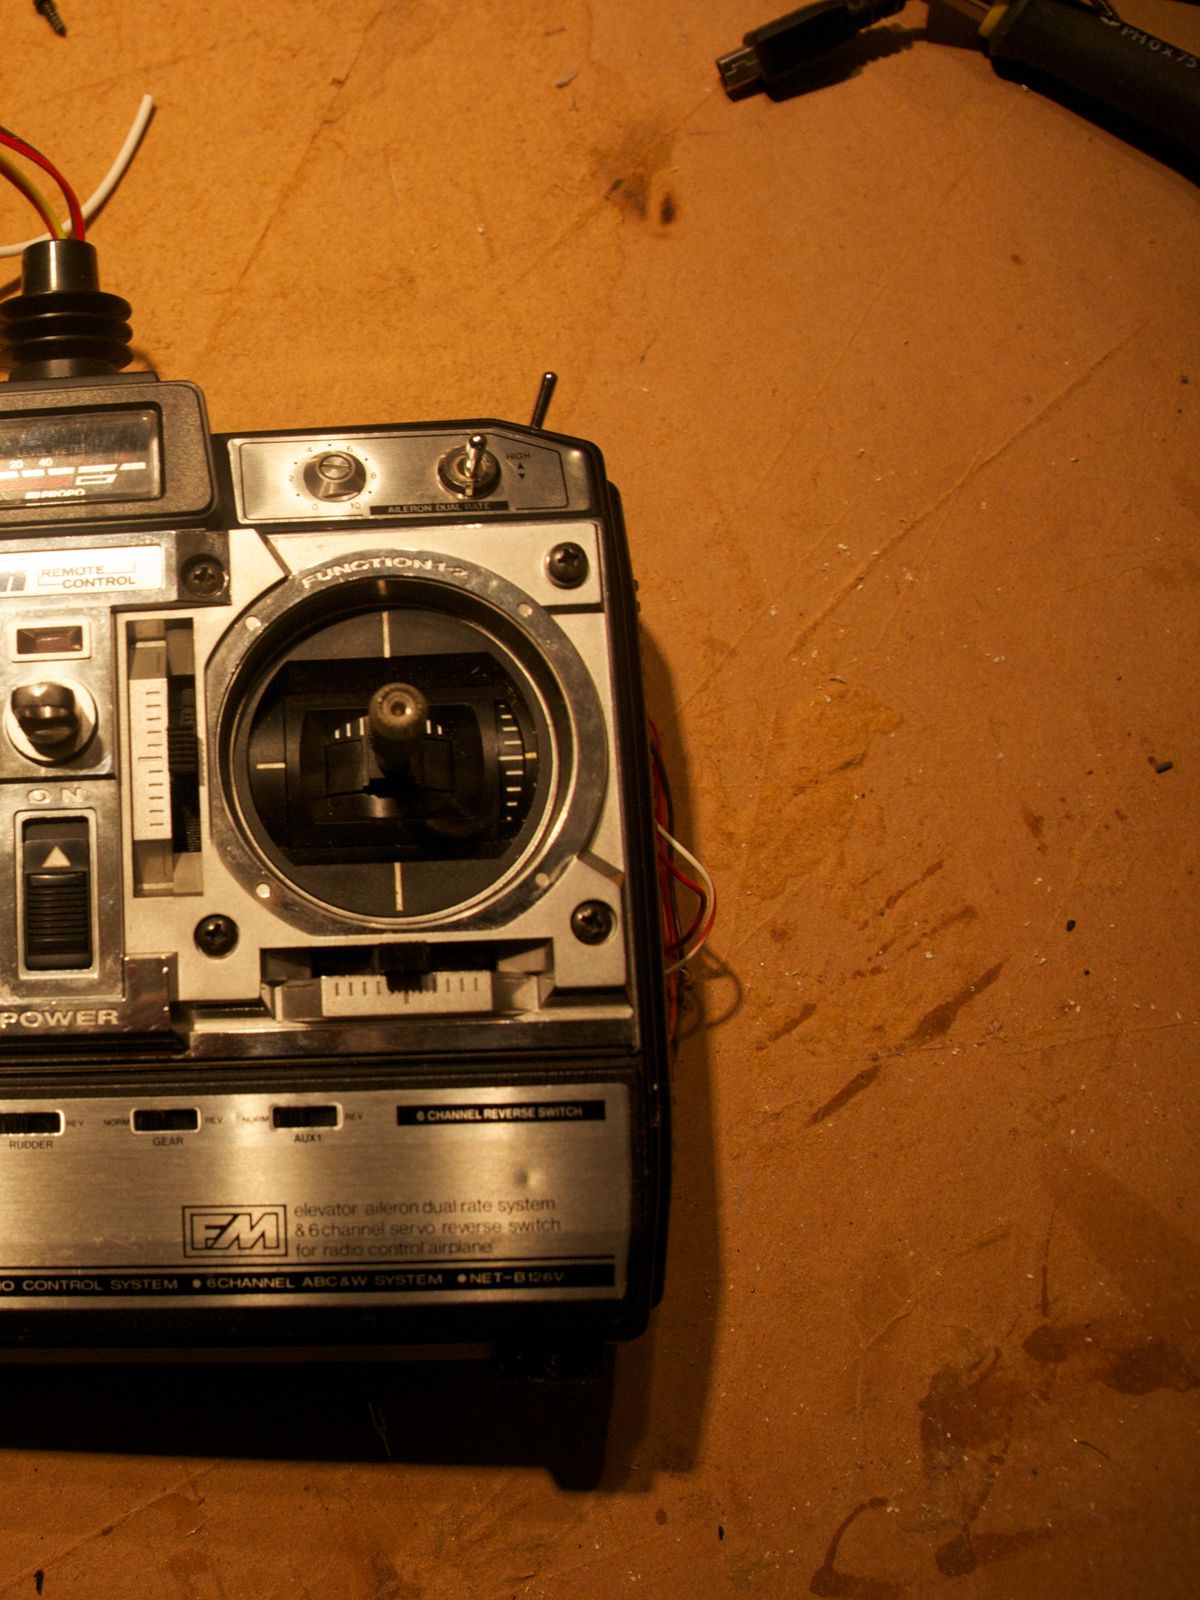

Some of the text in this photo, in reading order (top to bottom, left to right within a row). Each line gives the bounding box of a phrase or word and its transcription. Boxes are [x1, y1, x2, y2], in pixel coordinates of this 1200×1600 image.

[388, 502, 491, 514] AILERON DUAL RATE
[41, 566, 105, 578] REMOTE
[301, 556, 433, 589] FUNCTION
[62, 576, 136, 590] CONTROL
[27, 787, 86, 804] ON
[0, 1010, 120, 1028] POWER
[415, 1106, 583, 1121] 6 CHANNEL REVERSE SWITCH
[9, 1140, 53, 1149] RUDDER
[152, 1136, 184, 1146] GEAR
[294, 1133, 322, 1143] AUX1
[294, 1198, 556, 1217] elevator aileron dual rate system
[191, 1212, 280, 1251] FM
[390, 1223, 436, 1236] servo
[441, 1221, 501, 1234] reverse
[508, 1218, 562, 1233] switch
[295, 1240, 493, 1257] for radio control airplane
[22, 1279, 104, 1292] CONTROL
[110, 1278, 179, 1290] SYSTEM
[374, 1273, 444, 1286] SYSTEM
